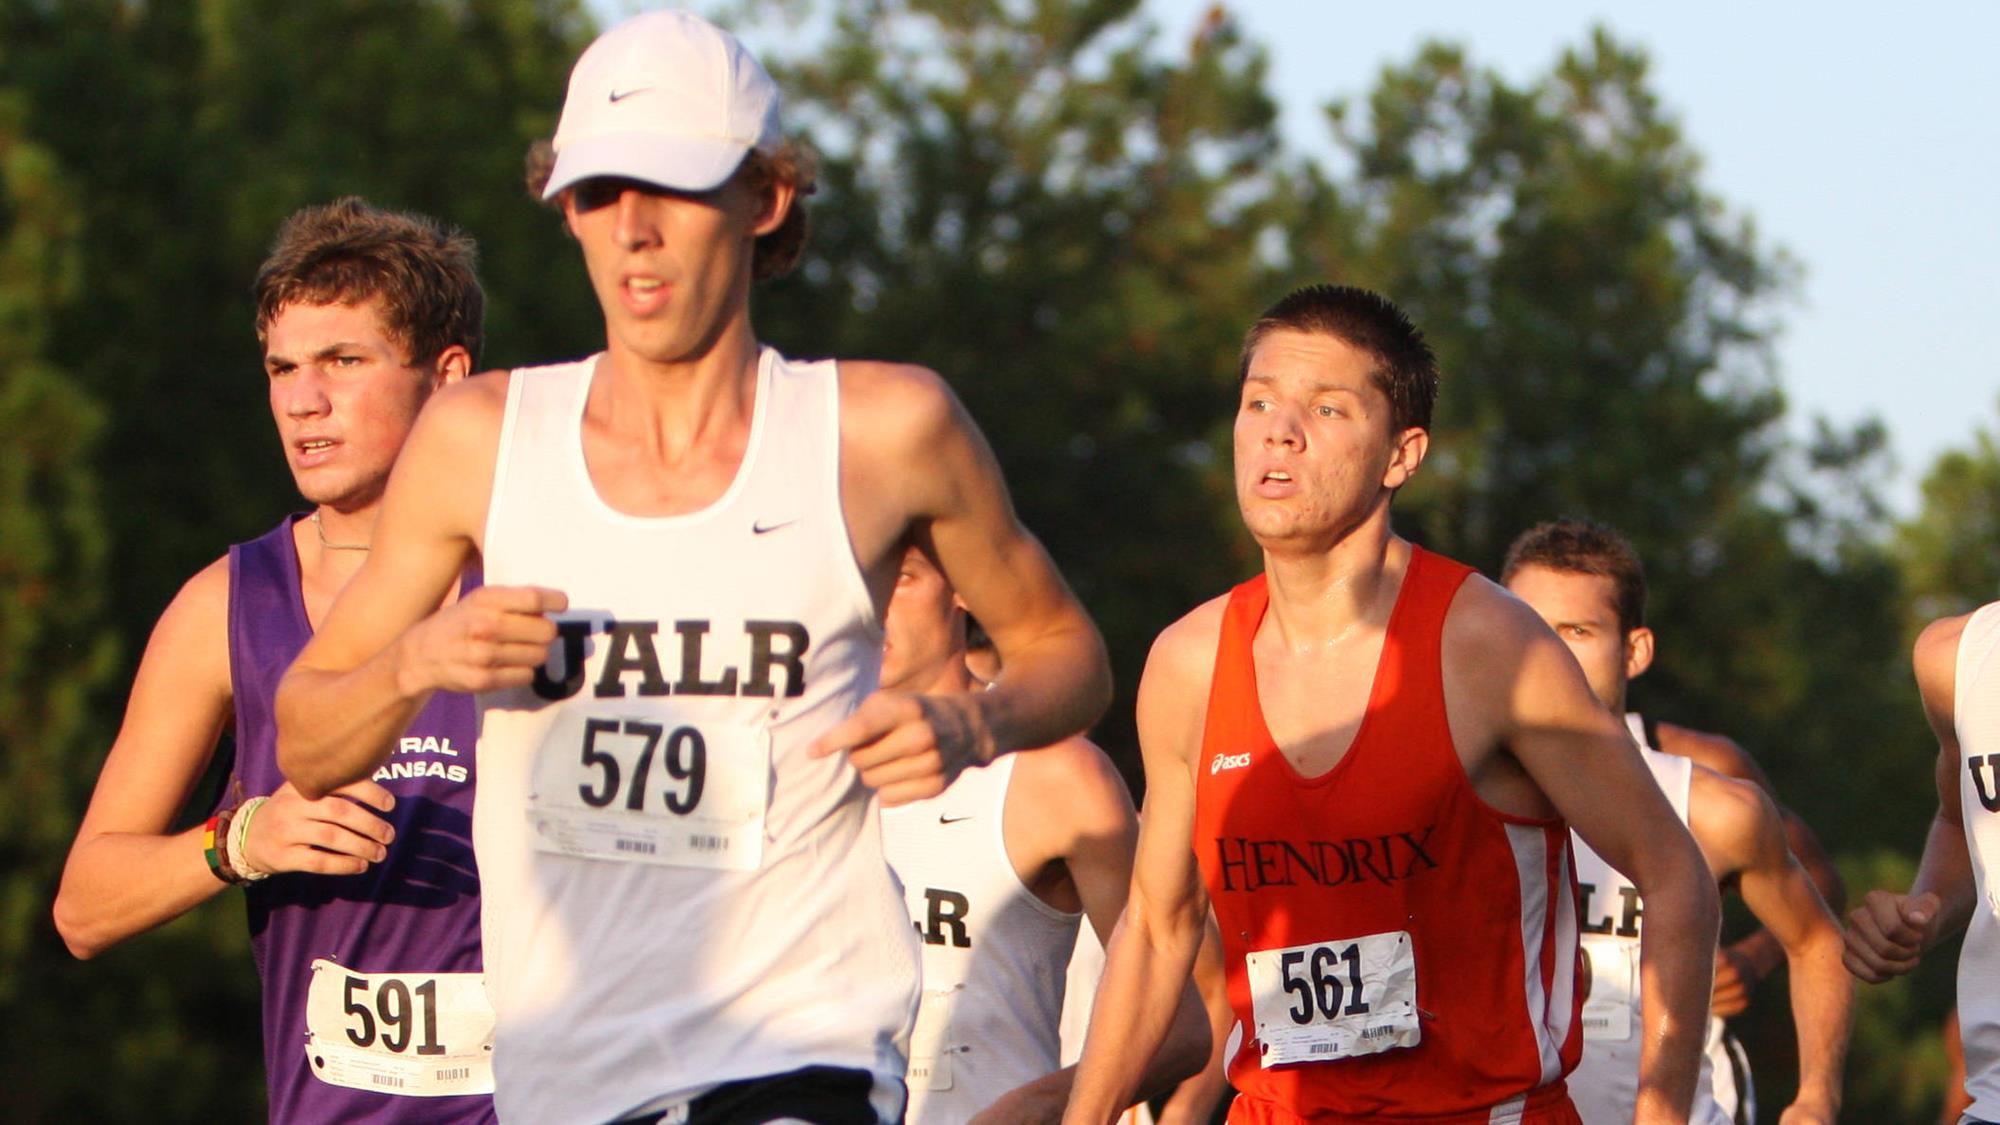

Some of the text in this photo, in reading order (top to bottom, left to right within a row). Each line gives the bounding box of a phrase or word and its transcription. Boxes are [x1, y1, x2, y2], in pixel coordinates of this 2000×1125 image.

[532, 619, 810, 699] UALR
[391, 736, 459, 756] RAL
[577, 717, 707, 816] 579
[1215, 824, 1439, 892] HENDRIX
[913, 887, 972, 948] R
[343, 975, 446, 1056] 591
[1281, 943, 1370, 1025] 561
